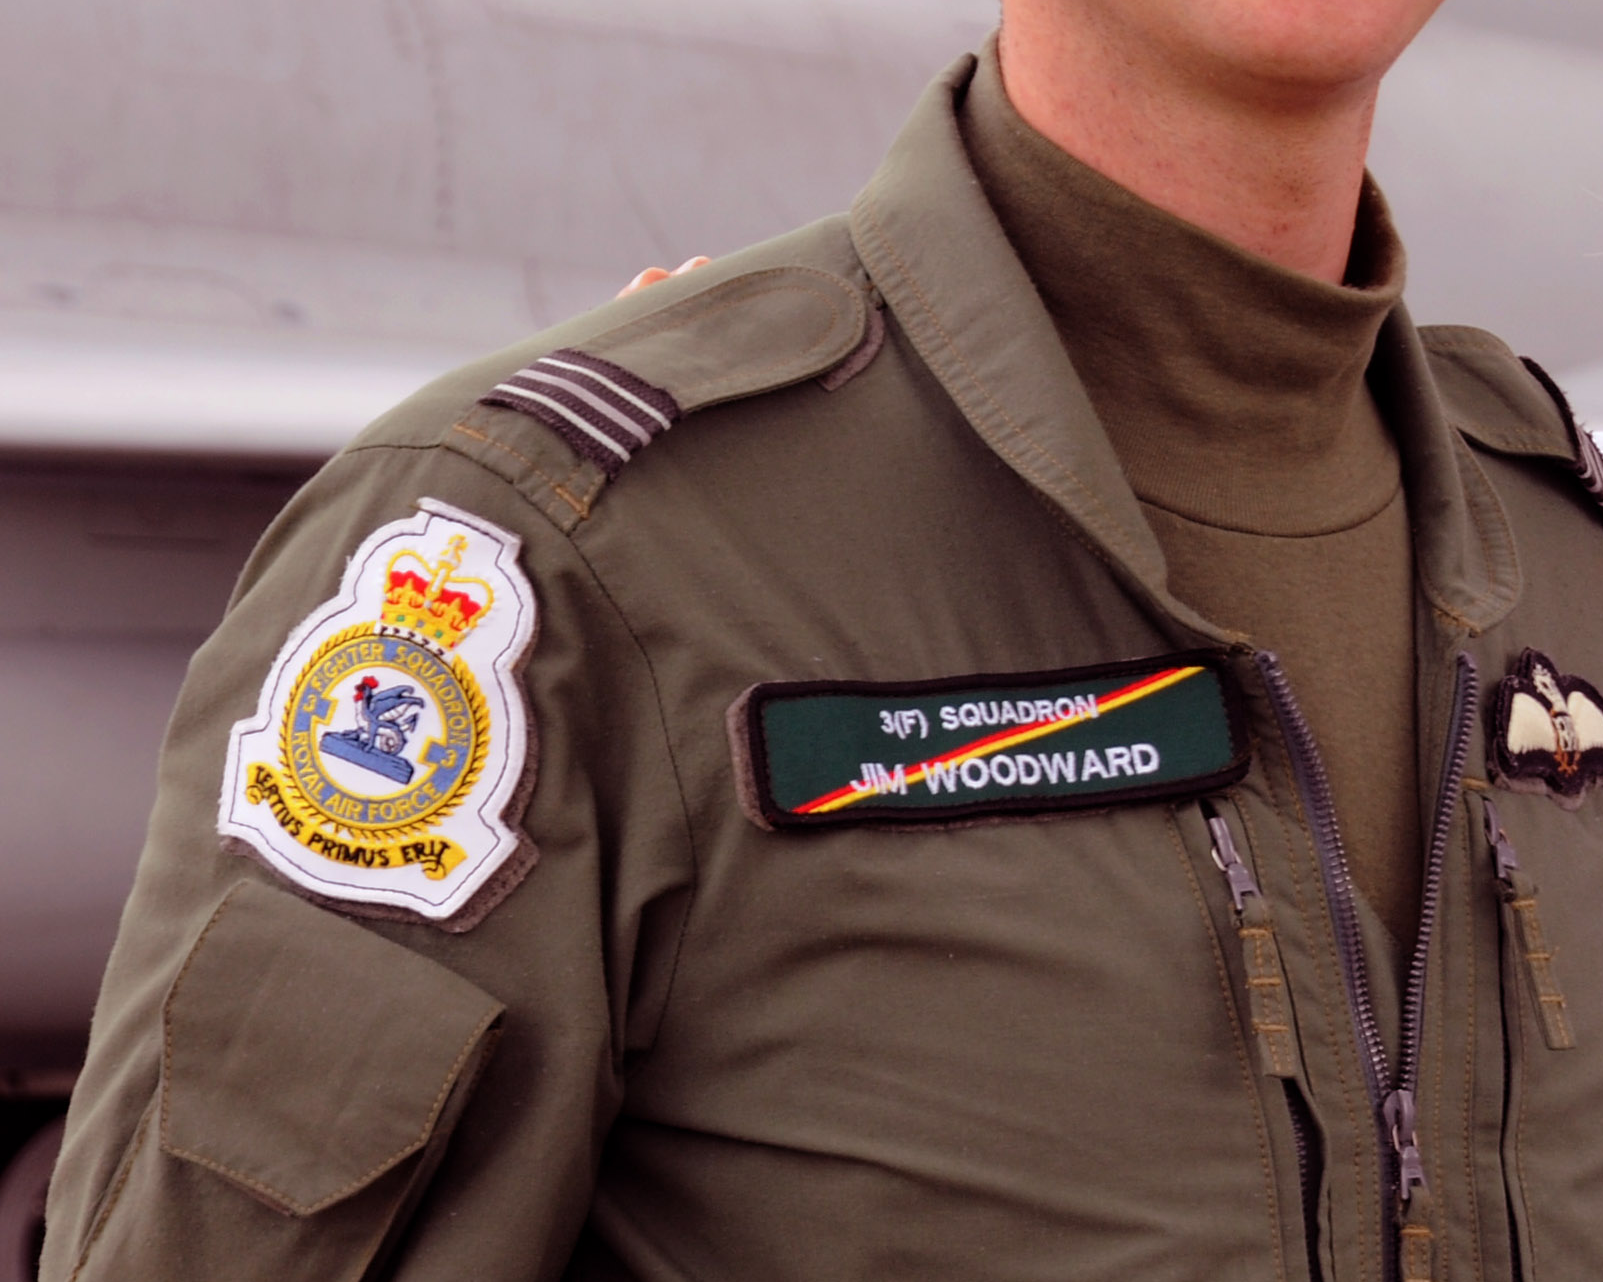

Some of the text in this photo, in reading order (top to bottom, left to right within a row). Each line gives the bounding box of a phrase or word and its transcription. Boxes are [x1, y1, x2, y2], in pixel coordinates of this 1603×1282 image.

[311, 642, 386, 692] FIGHTER
[396, 644, 470, 747] SQUADRON
[880, 694, 1099, 739] 3(F) SQUADRON
[294, 731, 443, 822] ROYAL AIR FORCE
[849, 743, 1160, 796] JIM WOODWARD
[255, 765, 451, 868] TERTIUS PRIMUS ERIT
